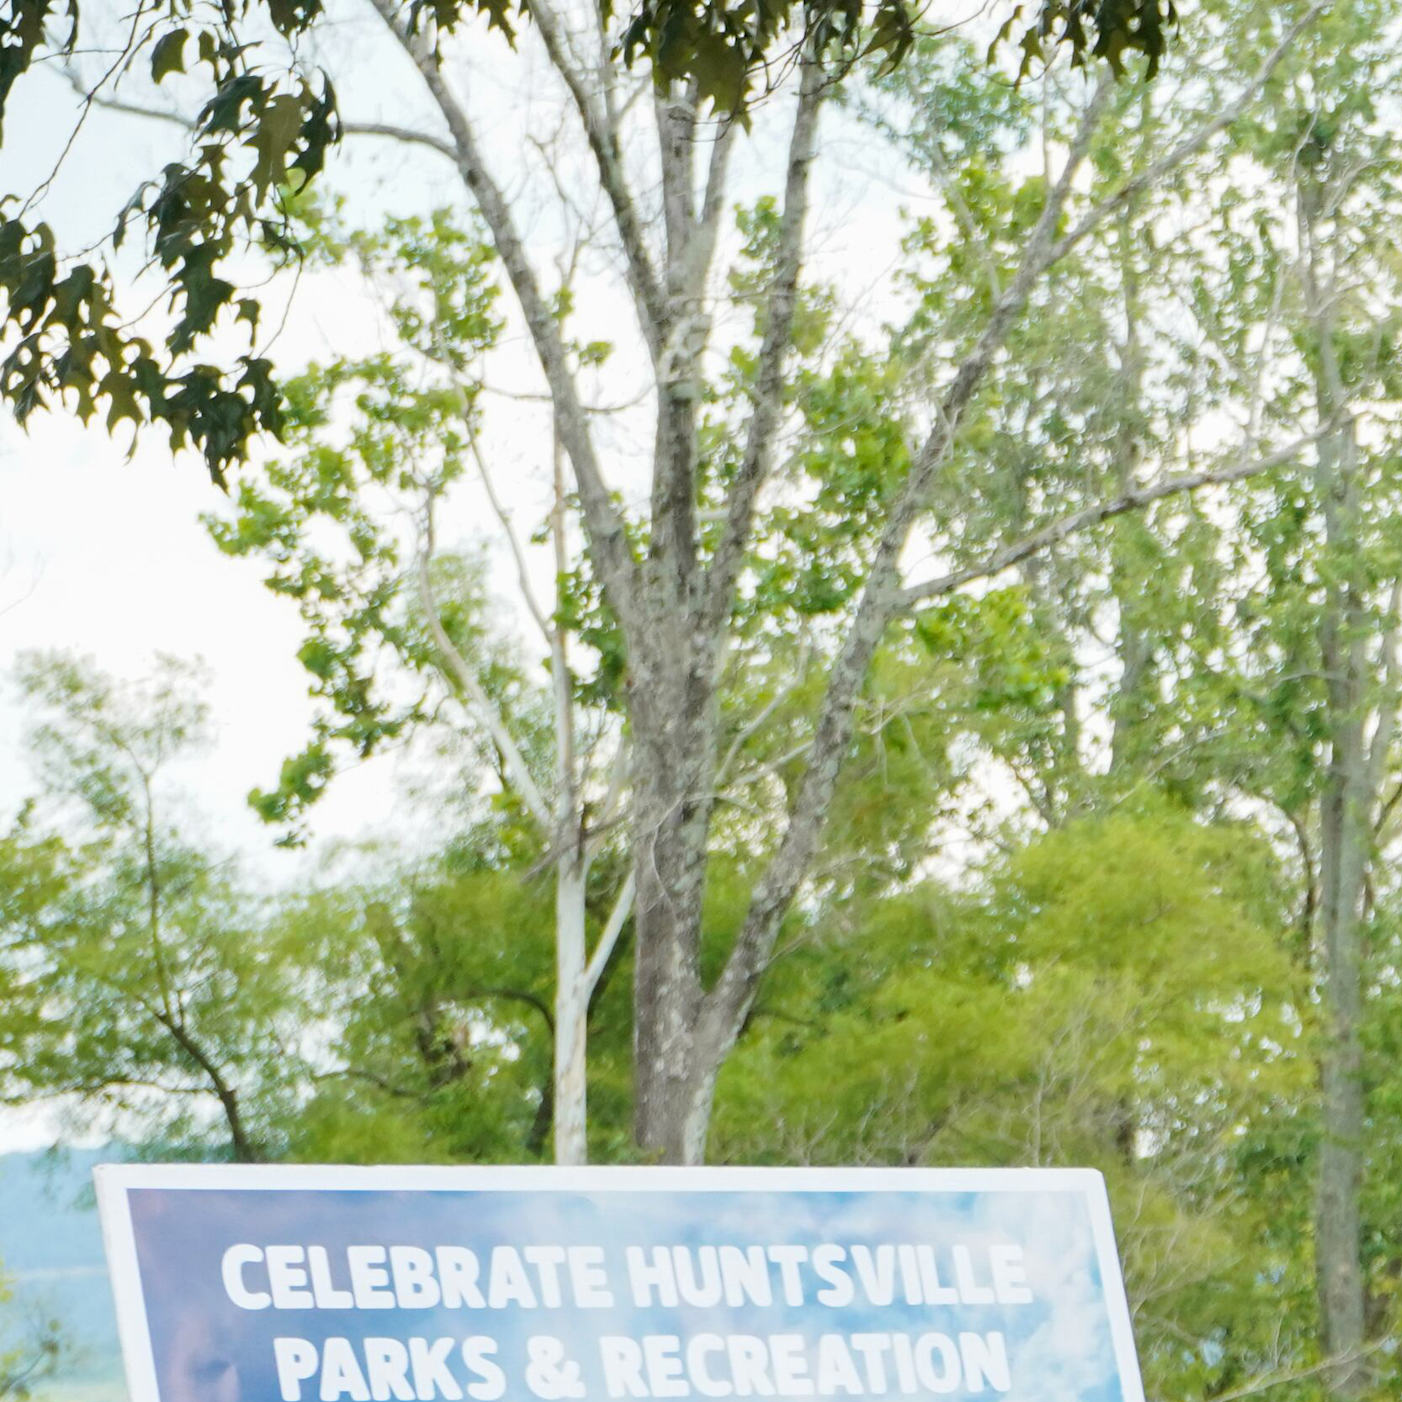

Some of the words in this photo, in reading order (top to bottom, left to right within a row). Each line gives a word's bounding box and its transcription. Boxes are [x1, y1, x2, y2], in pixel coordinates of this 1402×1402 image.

[221, 1243, 614, 1310] CELEBRATE
[627, 1244, 1033, 1307] HUNTSVILLE
[273, 1336, 506, 1402] PARKS
[525, 1336, 586, 1400] &
[599, 1331, 1011, 1398] RECREATION
